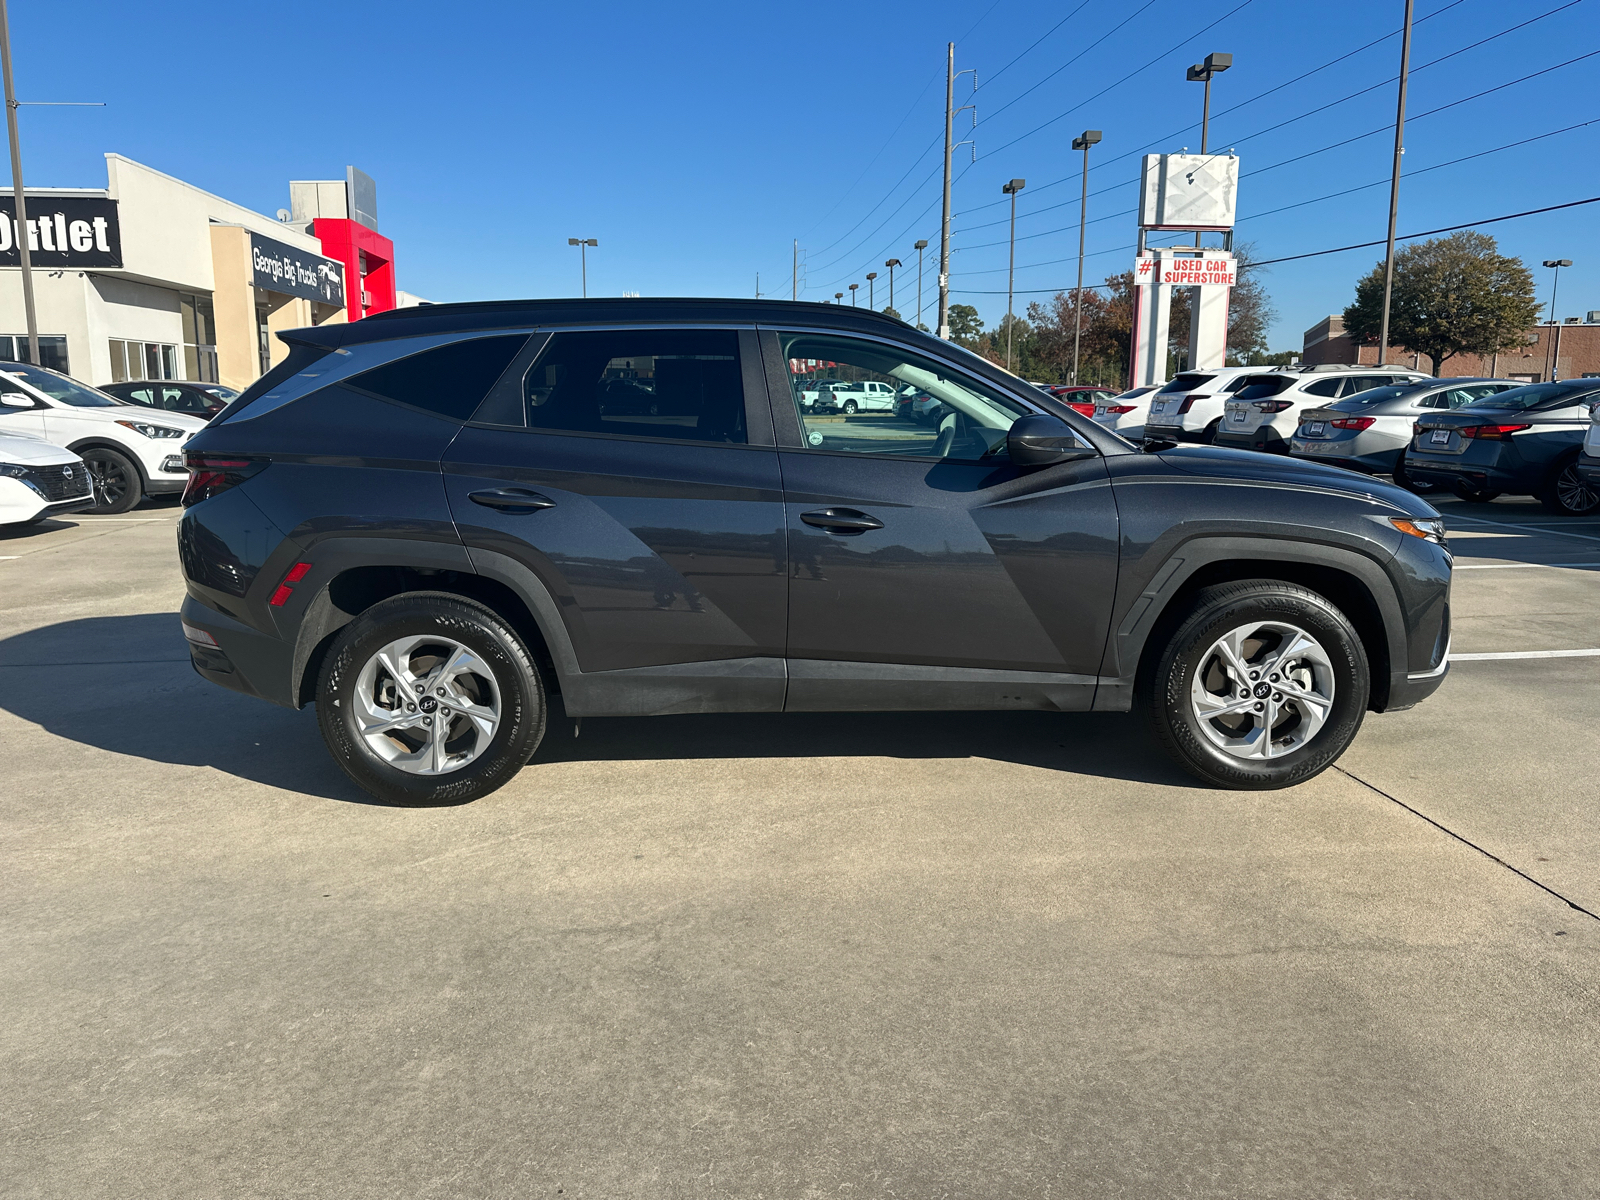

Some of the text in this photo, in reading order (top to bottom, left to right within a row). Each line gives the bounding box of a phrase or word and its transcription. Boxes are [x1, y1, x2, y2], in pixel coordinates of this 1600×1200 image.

[253, 247, 317, 287] Georgia Big Trucks
[1139, 259, 1162, 283] #1
[1174, 260, 1227, 272] USED CAR
[1165, 271, 1234, 284] SUPERSTORE
[1215, 765, 1272, 781] KUMHO
